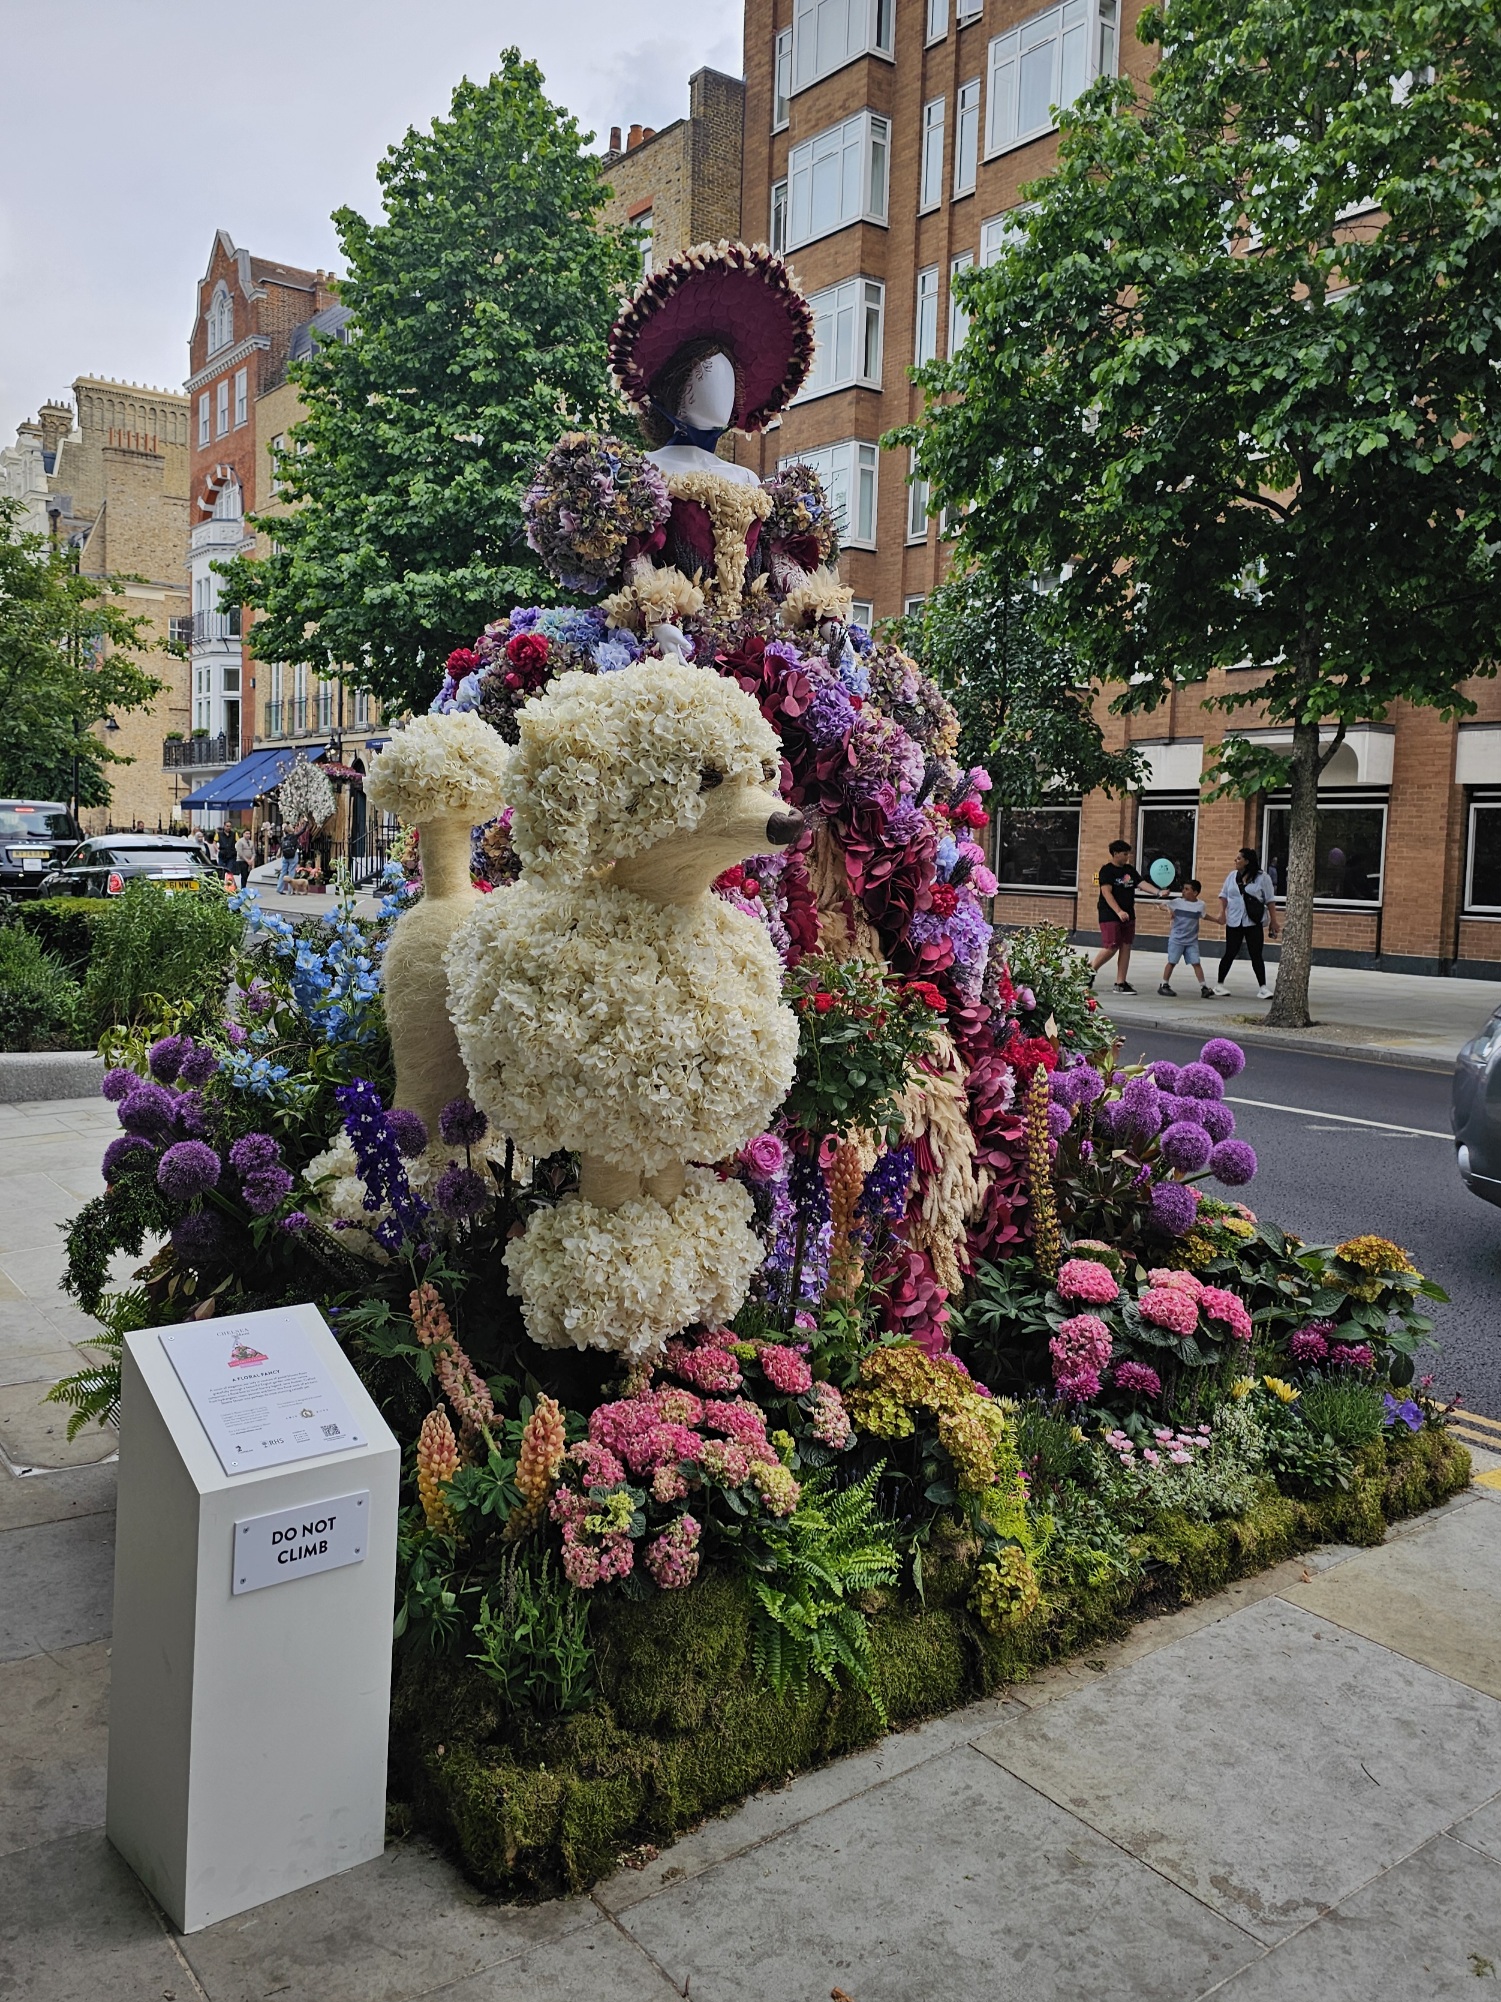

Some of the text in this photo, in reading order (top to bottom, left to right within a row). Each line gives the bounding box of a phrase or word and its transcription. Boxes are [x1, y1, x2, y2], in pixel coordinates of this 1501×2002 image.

[216, 1328, 249, 1336] CHELSEA
[260, 1369, 280, 1377] FANCY
[268, 1438, 285, 1446] RHS
[271, 1516, 336, 1545] DO NOT
[277, 1540, 328, 1564] CLIMB
